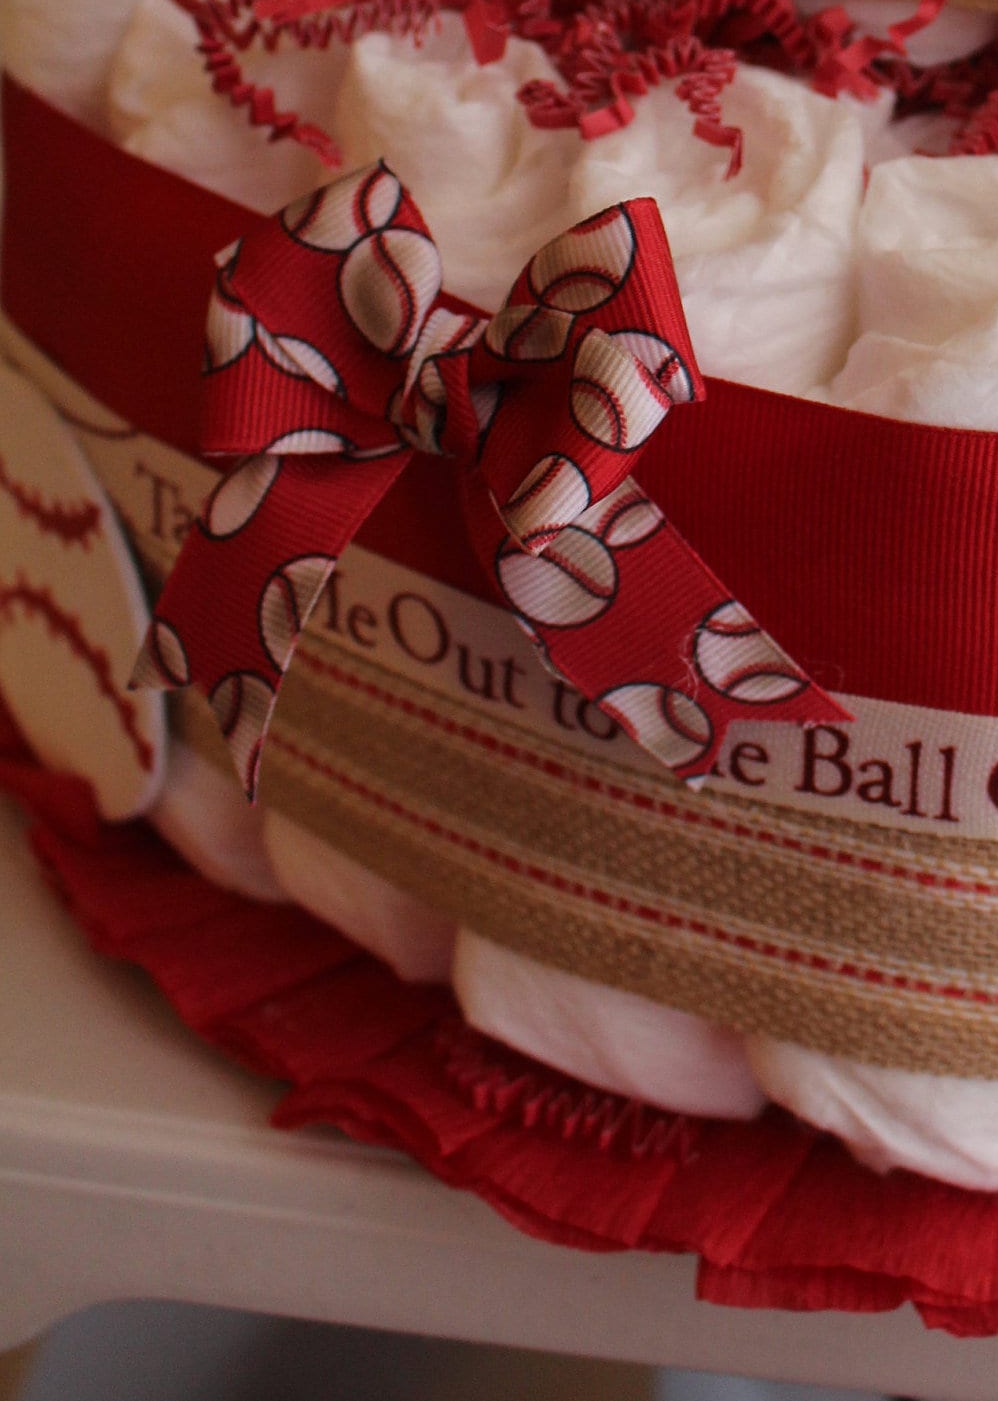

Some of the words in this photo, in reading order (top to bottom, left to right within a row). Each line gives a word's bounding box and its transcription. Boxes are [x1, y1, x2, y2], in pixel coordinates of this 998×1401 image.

[132, 460, 195, 542] Ta
[386, 592, 527, 710] Out
[793, 724, 962, 824] Ball
